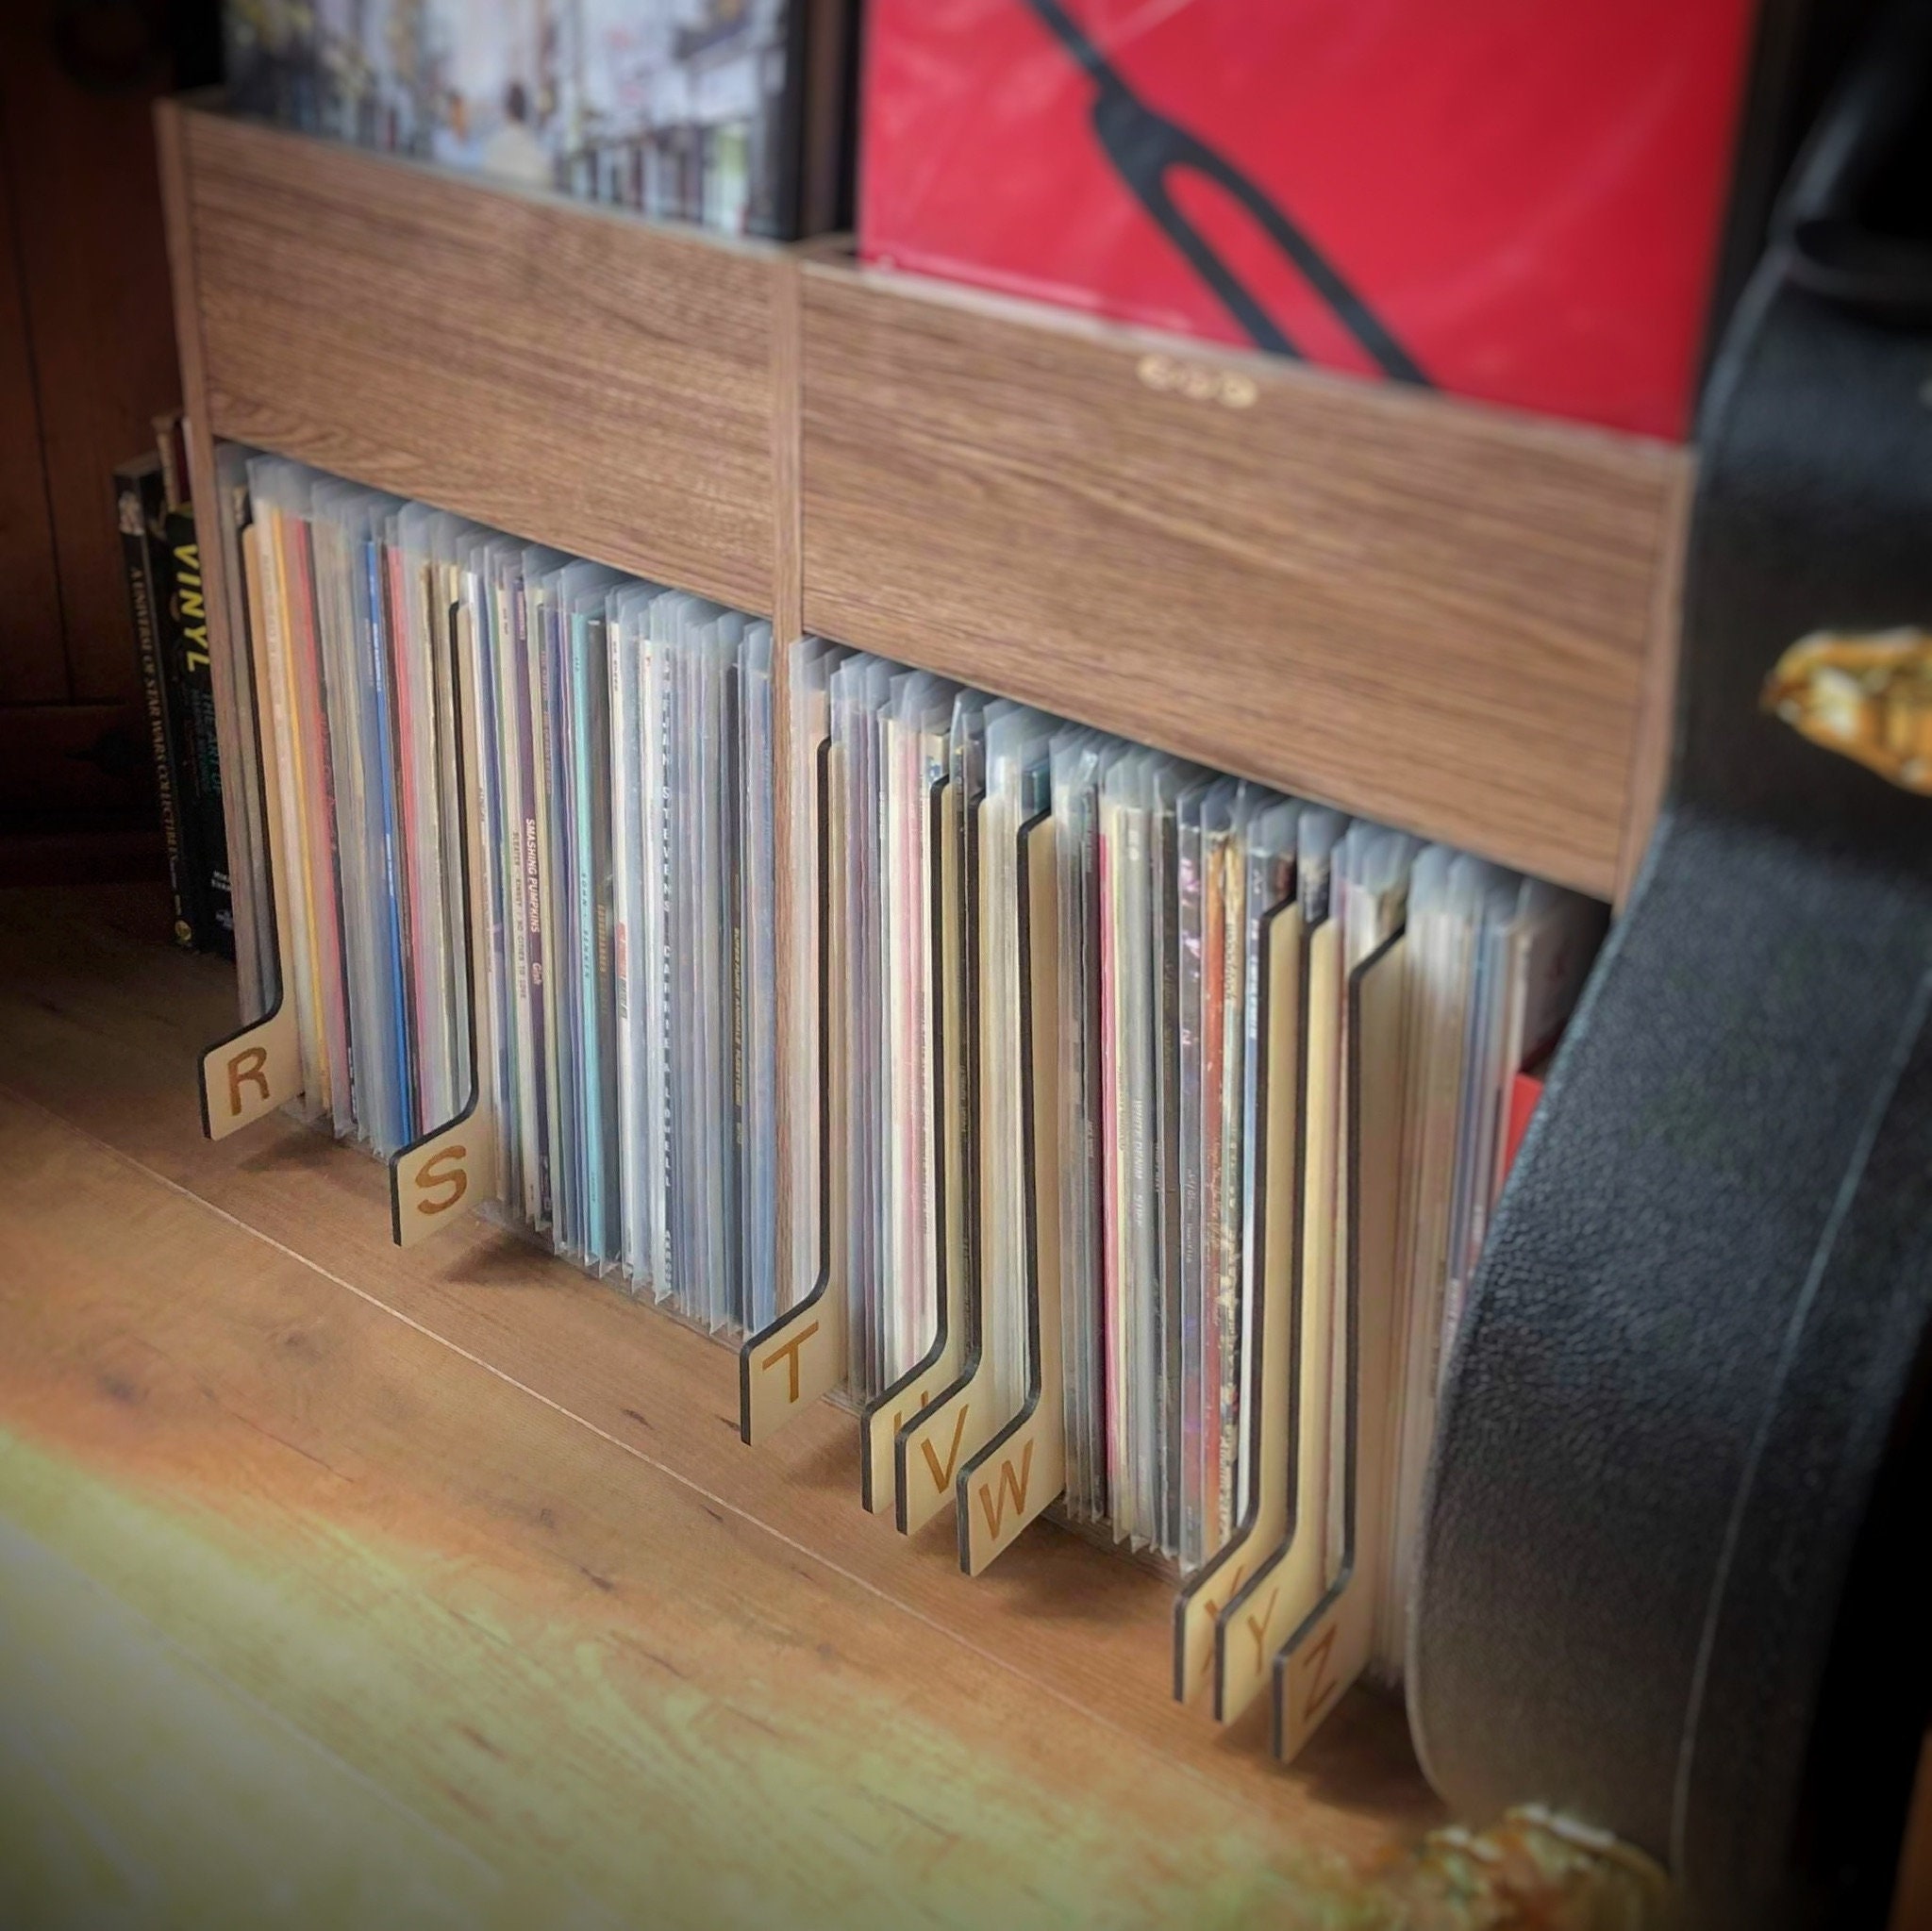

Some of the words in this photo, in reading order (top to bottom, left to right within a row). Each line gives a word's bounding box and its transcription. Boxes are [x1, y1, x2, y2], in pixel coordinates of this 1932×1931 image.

[173, 543, 211, 673] VINYL
[142, 677, 161, 717] STAR
[150, 720, 167, 761] WARS
[512, 832, 522, 866] SLEATER
[525, 818, 539, 875] SMASHING
[662, 786, 671, 913] STEVENS
[514, 878, 524, 907] KINNEY
[528, 877, 541, 933] PUMPKINS
[531, 961, 543, 986] Gish
[227, 1046, 271, 1117] R
[663, 1086, 672, 1188] LOWELL
[1133, 1100, 1143, 1136] WHITE
[414, 1144, 468, 1215] S
[1133, 1140, 1144, 1180] DENIM
[762, 1321, 820, 1404] T
[921, 1403, 970, 1494] V
[978, 1466, 1035, 1541] W
[1246, 1588, 1279, 1675] Y
[1302, 1623, 1339, 1723] Z
